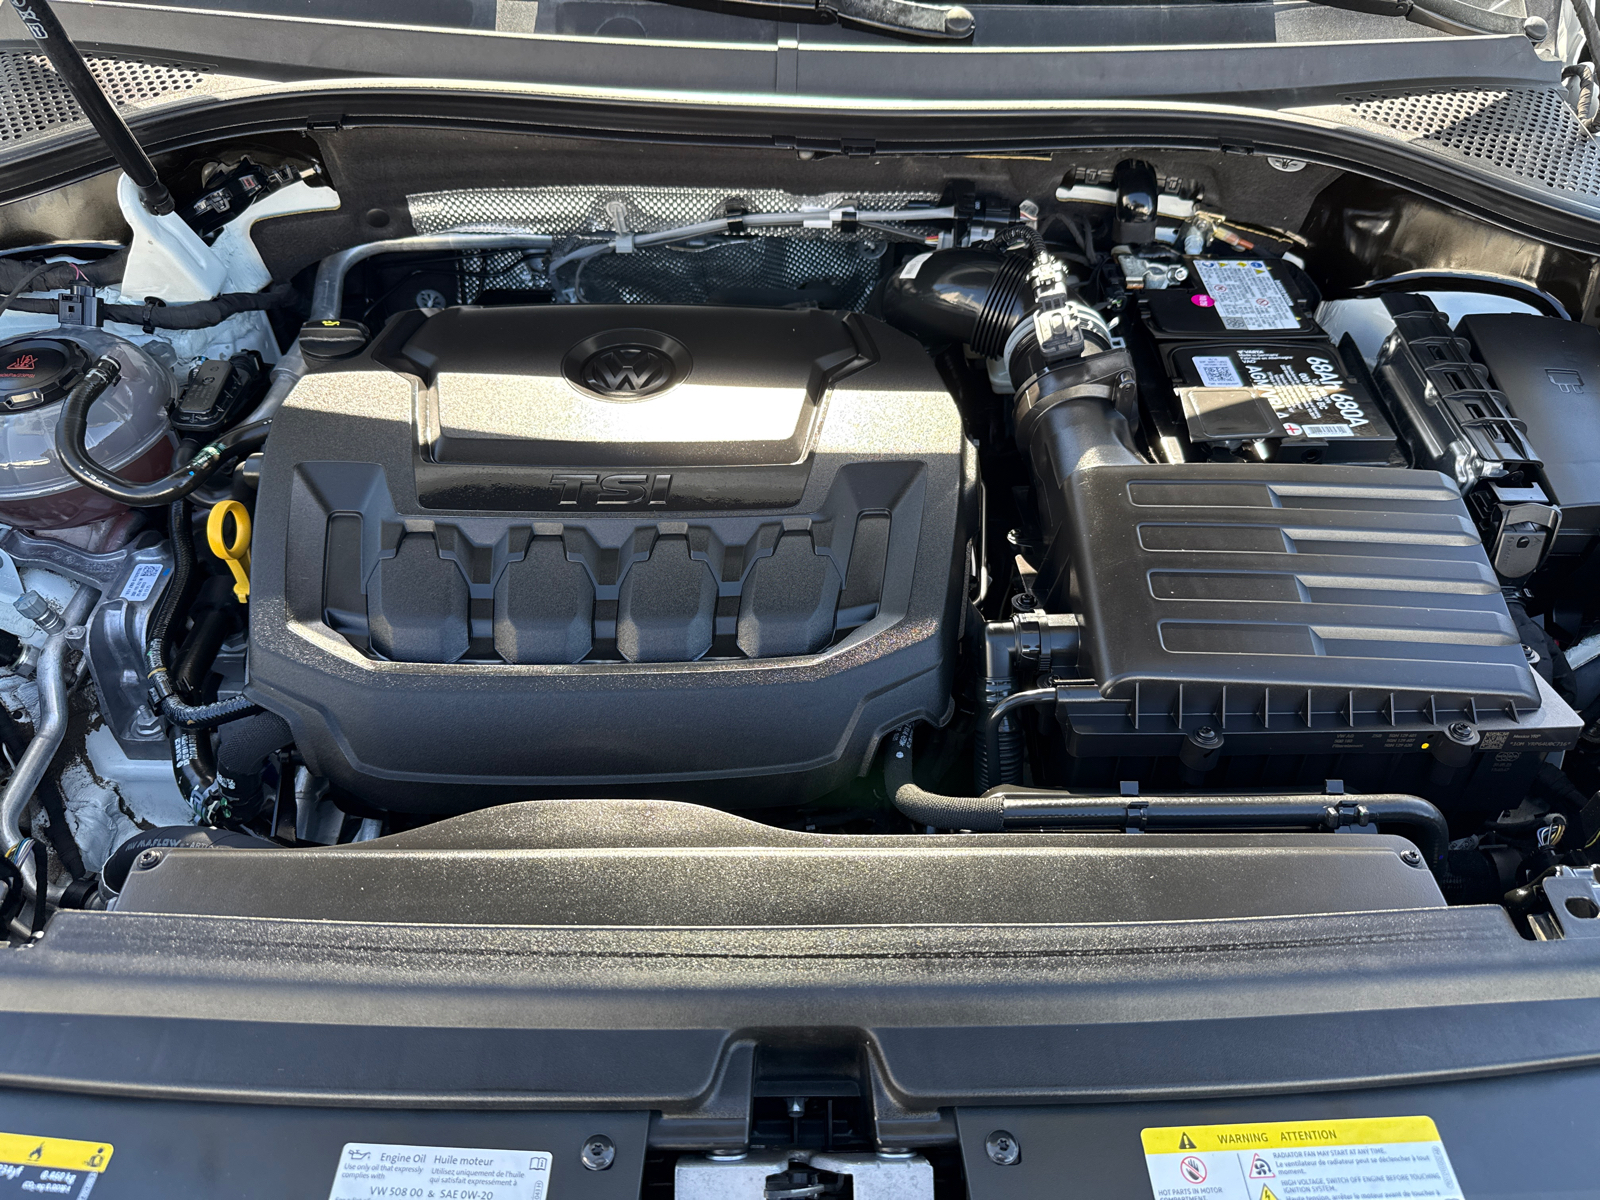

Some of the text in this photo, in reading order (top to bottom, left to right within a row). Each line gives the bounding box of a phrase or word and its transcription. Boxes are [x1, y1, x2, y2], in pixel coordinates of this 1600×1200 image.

[1306, 356, 1344, 390] 68Ah
[1330, 393, 1370, 428] 680A
[549, 473, 673, 506] TSI
[1217, 1129, 1338, 1145] WARNING ATTENTION
[380, 1153, 426, 1165] Engine Oil
[1272, 1150, 1303, 1159] RADIATOR
[1317, 1149, 1330, 1157] MAY
[1330, 1148, 1348, 1156] START
[1357, 1147, 1370, 1155] ANY
[434, 1154, 494, 1167] Huile moteur
[1284, 1160, 1317, 1168] ventilateur
[1326, 1158, 1354, 1166] radiateur
[1356, 1157, 1370, 1166] peut
[1416, 1154, 1430, 1162] tout
[343, 1162, 424, 1175] Use only oil that expressly
[431, 1167, 455, 1176] Utilisez
[456, 1169, 495, 1178] uniquement
[495, 1169, 505, 1178] de
[341, 1172, 386, 1180] complies with
[429, 1176, 518, 1187] qui satisfait expressément à
[1385, 1173, 1410, 1182] BEFORE
[370, 1186, 494, 1200] VW 508 00 & SAE 0W-20
[1158, 1186, 1223, 1196] HOT PARTS IN MOTOR
[1283, 1186, 1311, 1194] IGNITION
